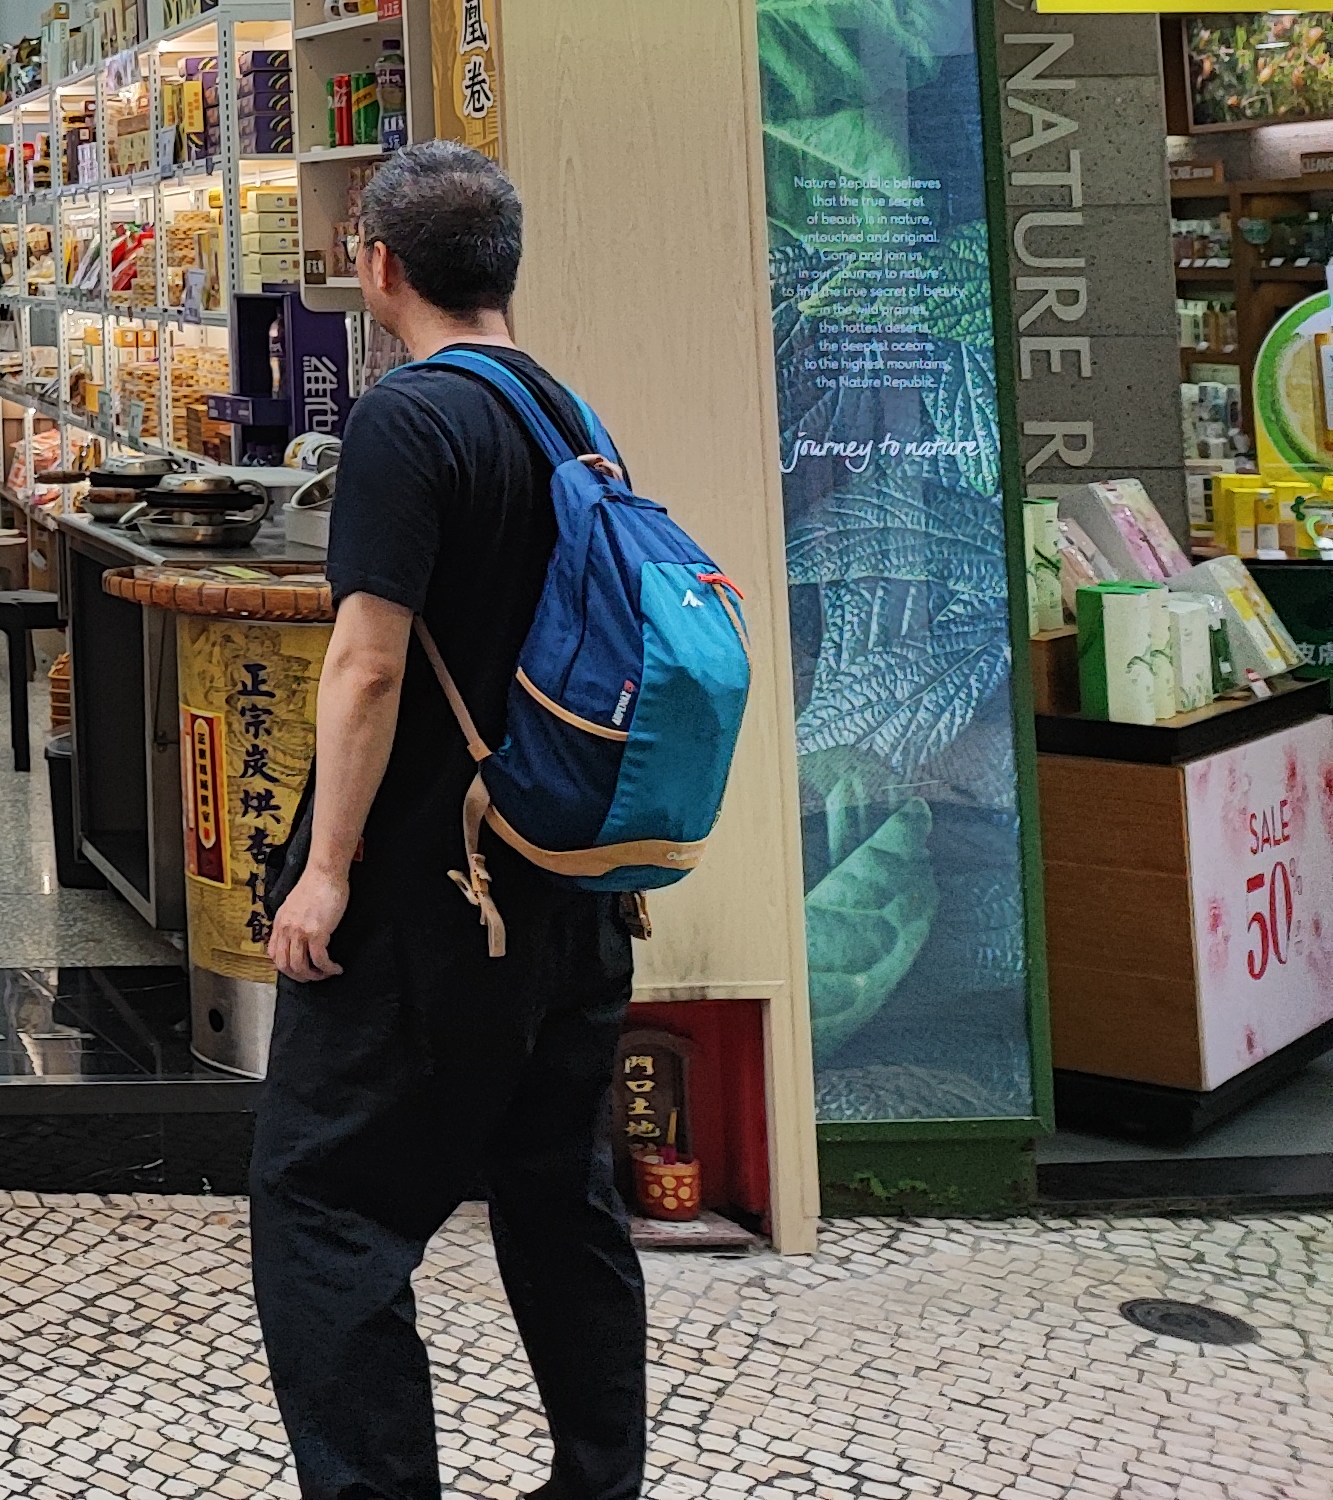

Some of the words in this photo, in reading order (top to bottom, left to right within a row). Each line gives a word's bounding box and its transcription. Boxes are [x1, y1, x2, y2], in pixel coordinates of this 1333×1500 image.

[794, 176, 836, 189] Nature
[839, 176, 890, 190] Republic
[893, 176, 941, 189] believes
[813, 195, 836, 207] that
[839, 195, 858, 207] the
[862, 196, 885, 207] true
[888, 197, 925, 207] secret
[1002, 32, 1092, 381] NATURE
[806, 212, 819, 224] of
[821, 212, 862, 227] beauty
[877, 213, 888, 224] in
[801, 231, 864, 243] untouched
[866, 231, 890, 243] and
[820, 250, 857, 261] Come
[859, 249, 883, 261] and
[884, 249, 905, 264] join
[798, 268, 809, 279] in
[884, 269, 897, 279] to
[796, 285, 820, 297] find
[821, 286, 840, 297] the
[843, 286, 867, 297] true
[869, 287, 907, 297] secret
[819, 322, 838, 334] the
[840, 322, 883, 334] hottest
[819, 340, 838, 352] the
[804, 359, 817, 370] to
[819, 358, 838, 370] the
[816, 376, 836, 388] the
[840, 376, 881, 388] Nature
[778, 431, 874, 473] journey
[878, 431, 900, 457] to
[904, 437, 983, 458] nature
[1249, 799, 1290, 855] SALE
